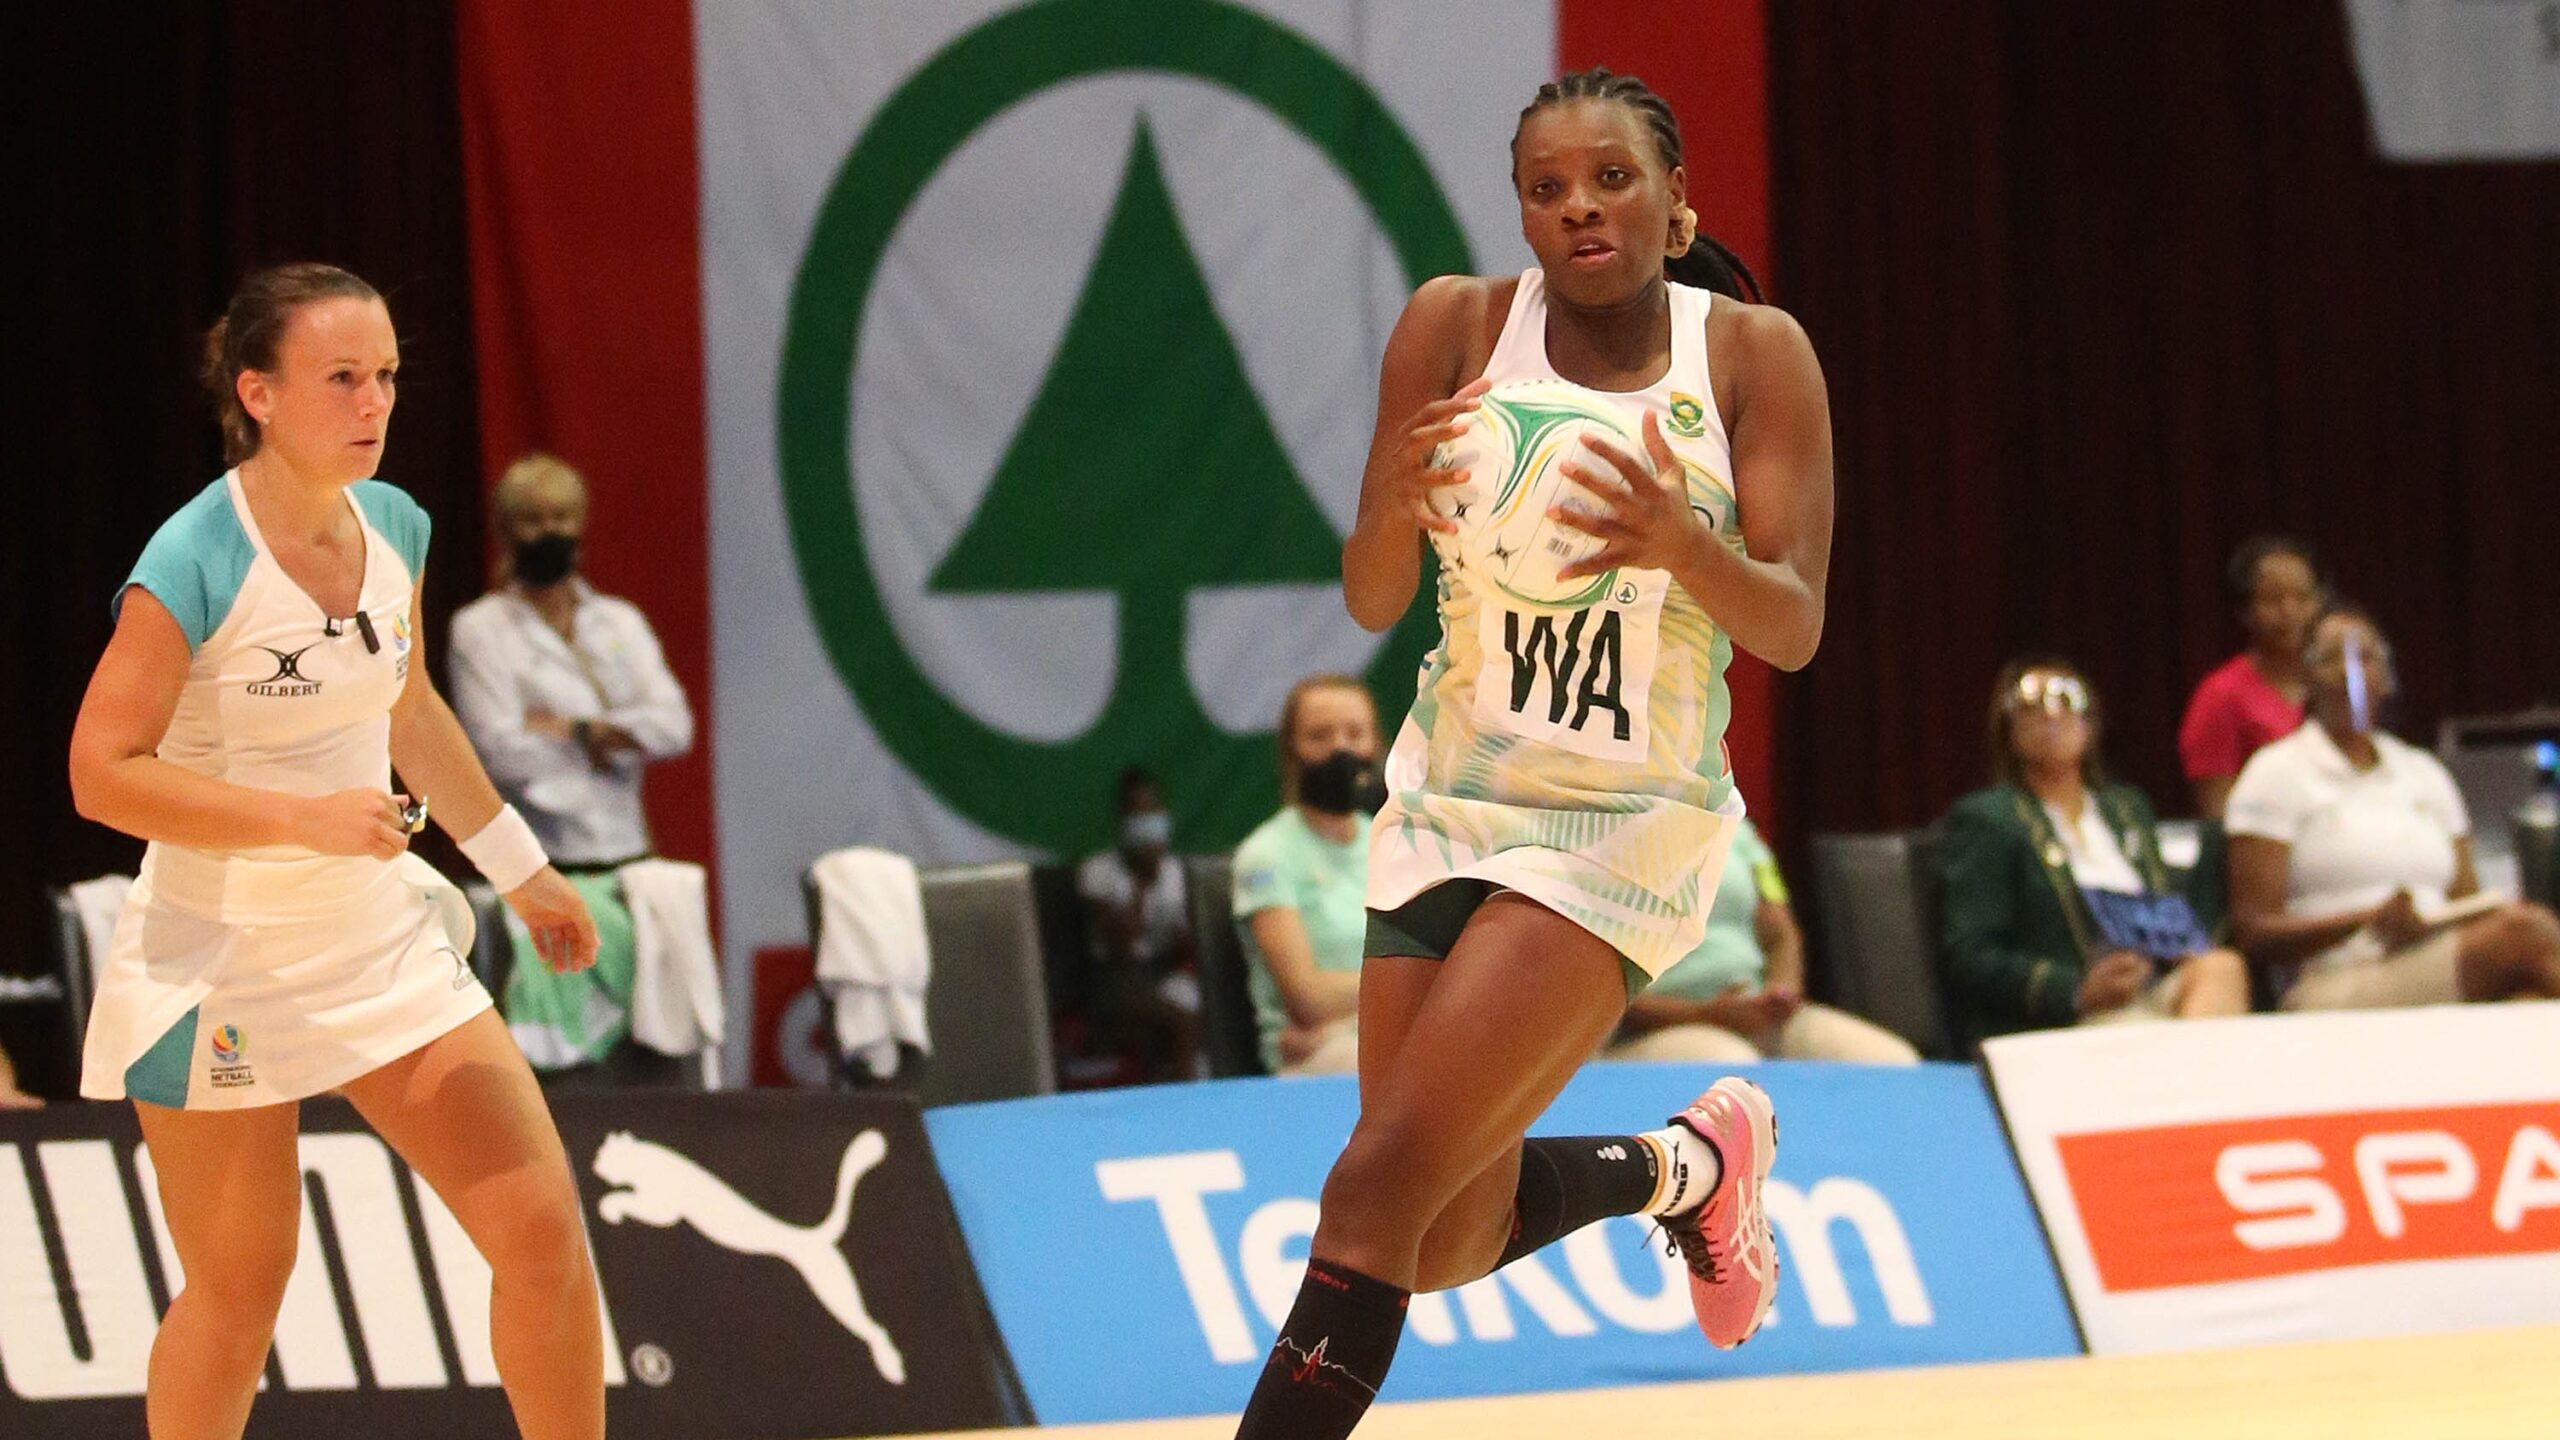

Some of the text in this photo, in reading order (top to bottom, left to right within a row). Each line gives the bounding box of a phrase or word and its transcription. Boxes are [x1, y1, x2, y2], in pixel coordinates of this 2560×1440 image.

[246, 683, 322, 697] GILBERT
[1504, 607, 1630, 741] WA
[2214, 1125, 2560, 1251] SPA
